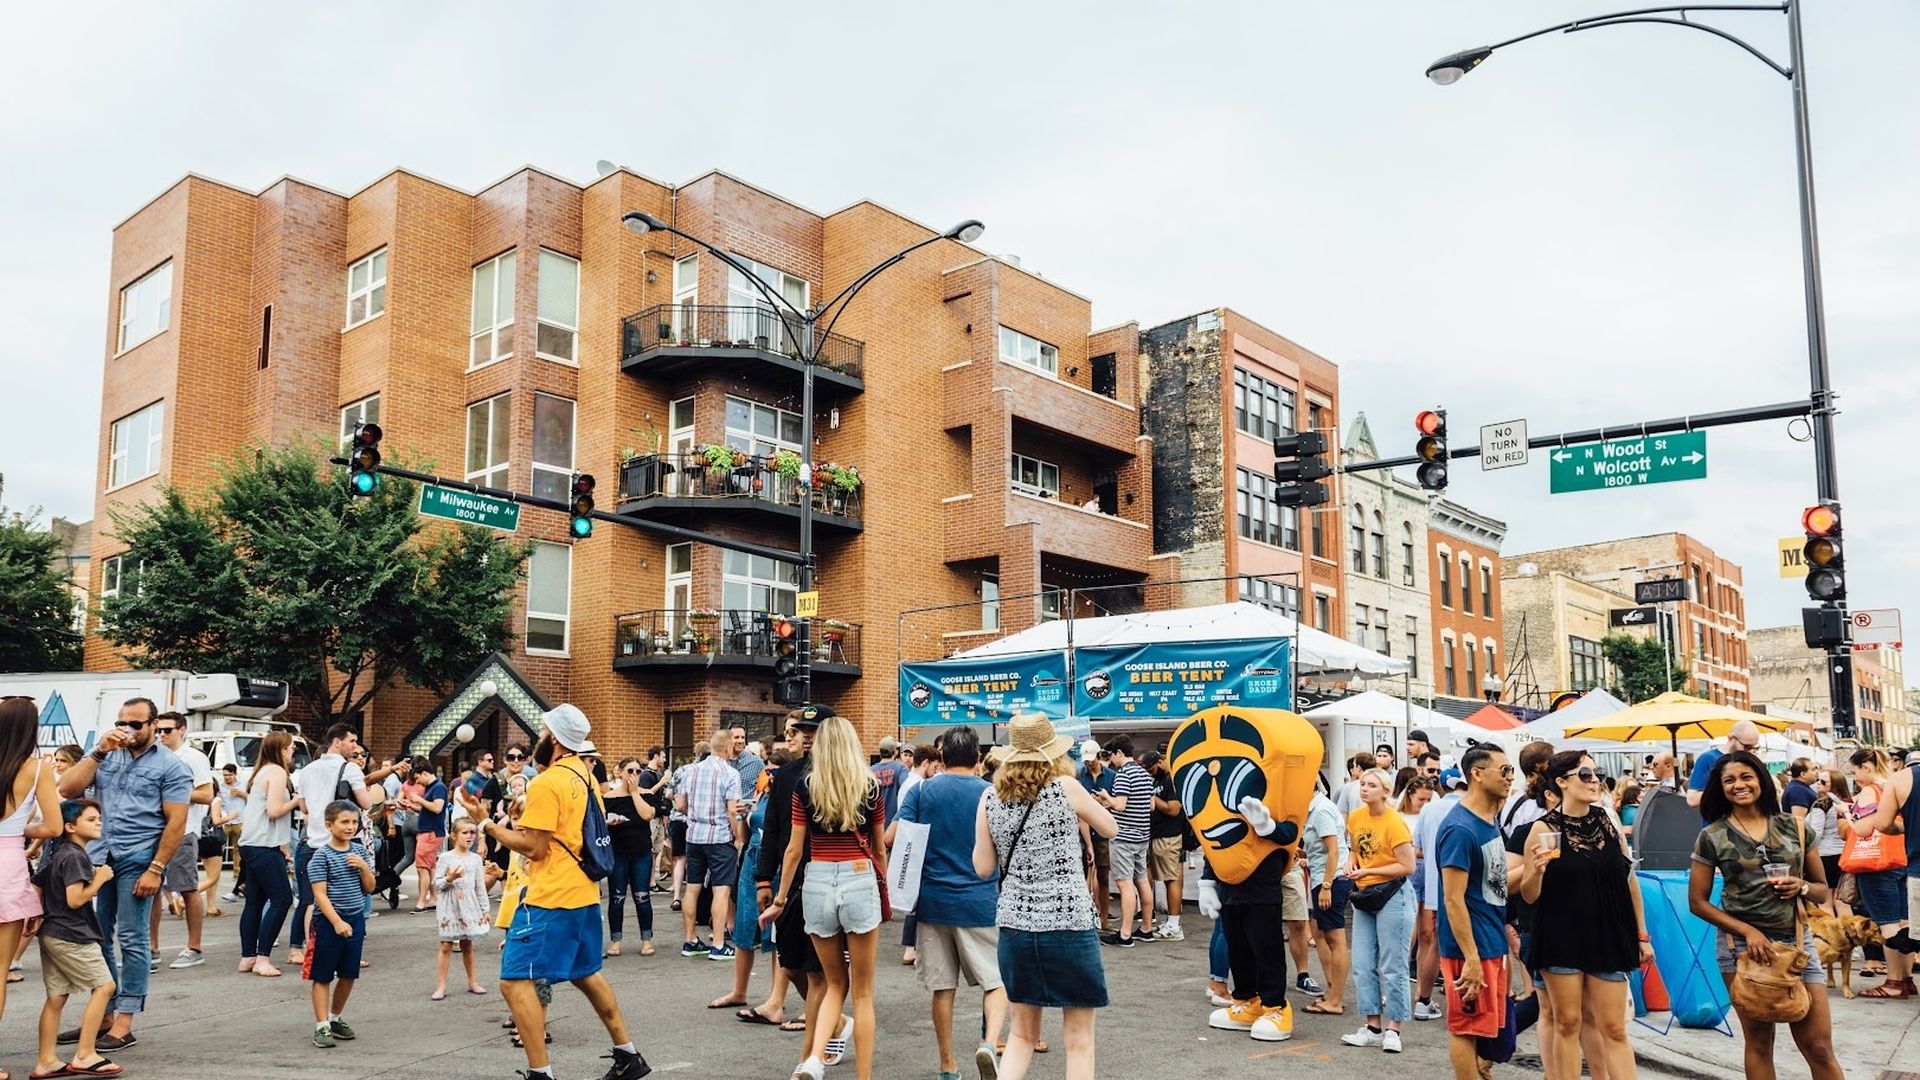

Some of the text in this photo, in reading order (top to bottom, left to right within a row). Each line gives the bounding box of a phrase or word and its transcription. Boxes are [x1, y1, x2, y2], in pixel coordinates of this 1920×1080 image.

[1495, 427, 1512, 437] NO
[1490, 439, 1518, 450] TURN
[1585, 440, 1667, 458] N Wood St
[1486, 451, 1524, 465] ON RED
[1576, 456, 1677, 476] N Wolcott Av
[1604, 473, 1648, 487] 1800 W
[427, 490, 515, 516] N Milwaukee Av
[456, 509, 486, 521] 1800 W
[1641, 582, 1680, 599] ATM
[1125, 660, 1230, 671] GOOSE ISLAND BEER CO.
[252, 679, 279, 687] CARRIER
[941, 676, 963, 684] GOOSE
[964, 674, 989, 682] ISLAND
[1130, 669, 1224, 684] BEER TENT
[944, 683, 979, 695] BEER
[983, 681, 1018, 692] TENT
[38, 725, 77, 746] OLAR
[1376, 730, 1387, 742] H2
[1515, 733, 1530, 742] 729
